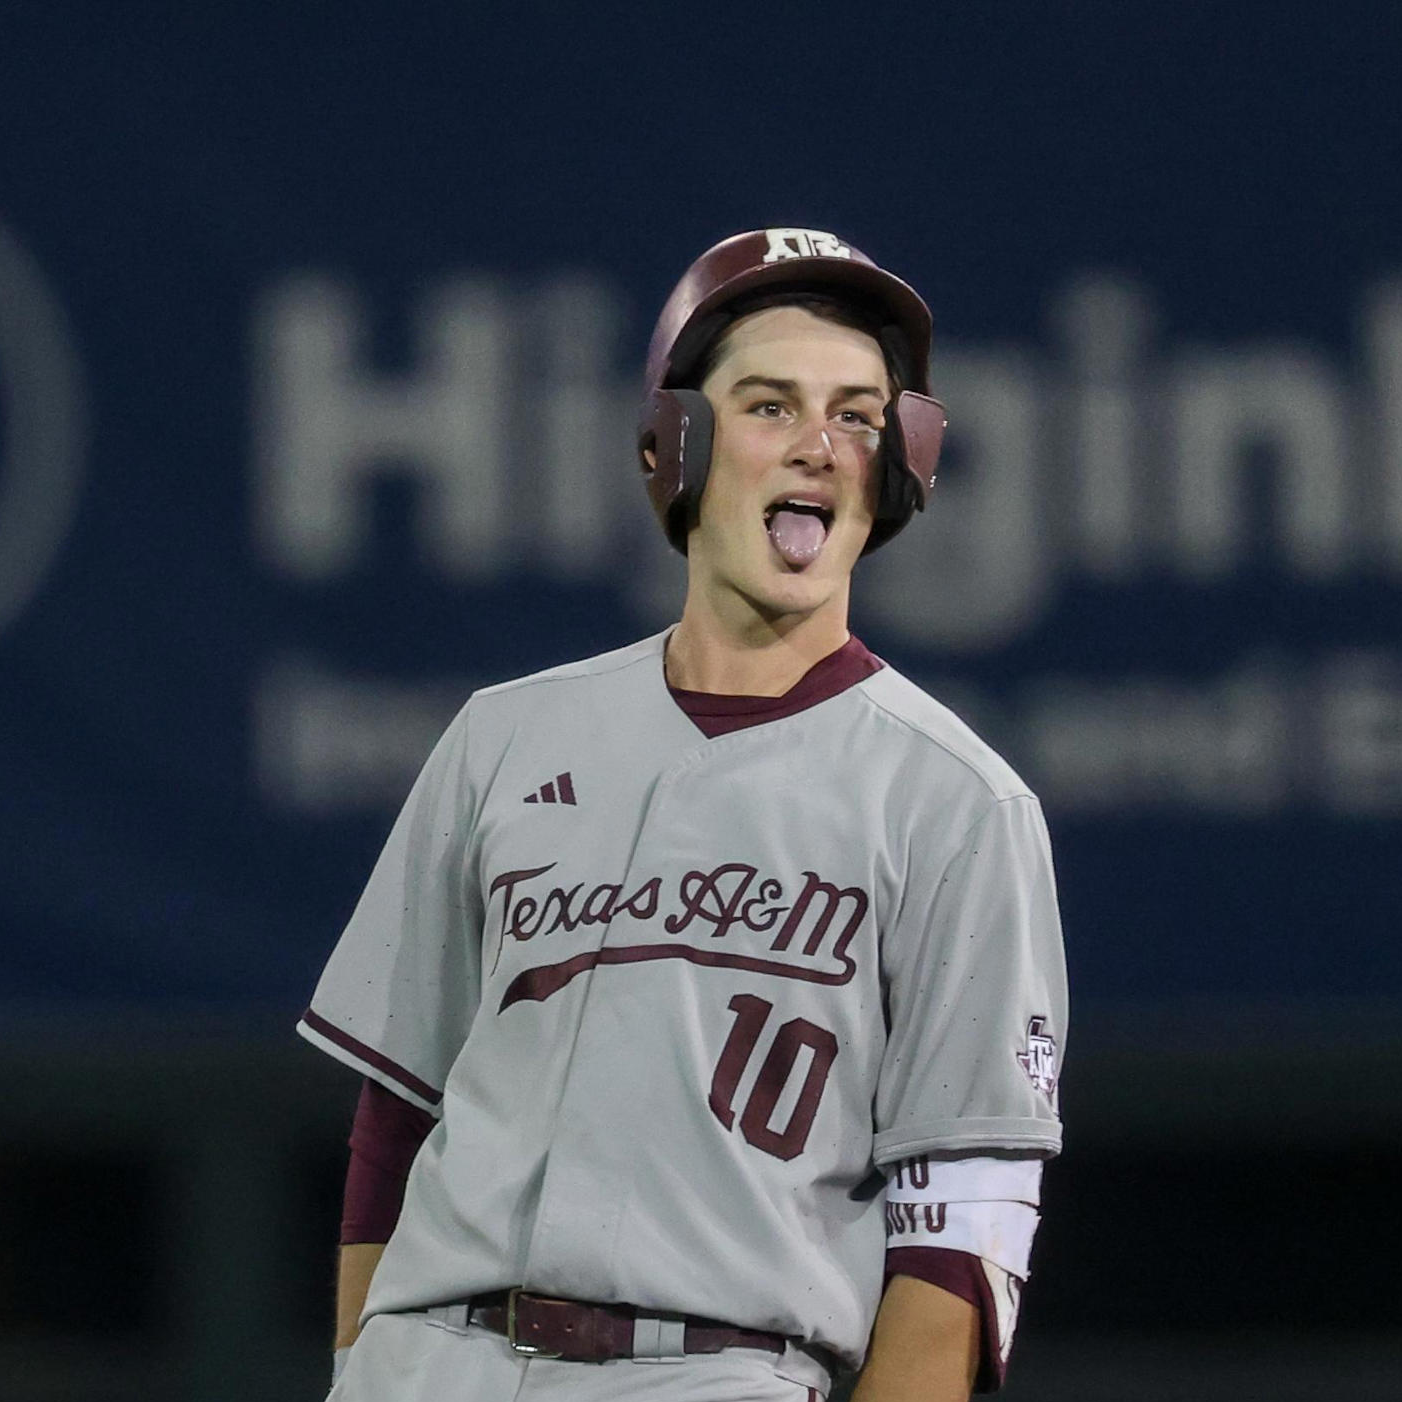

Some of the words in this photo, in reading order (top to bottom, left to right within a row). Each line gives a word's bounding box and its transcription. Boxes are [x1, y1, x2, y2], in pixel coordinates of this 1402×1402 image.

[489, 861, 663, 976] Texas
[664, 862, 869, 962] A&M
[708, 993, 839, 1162] 10
